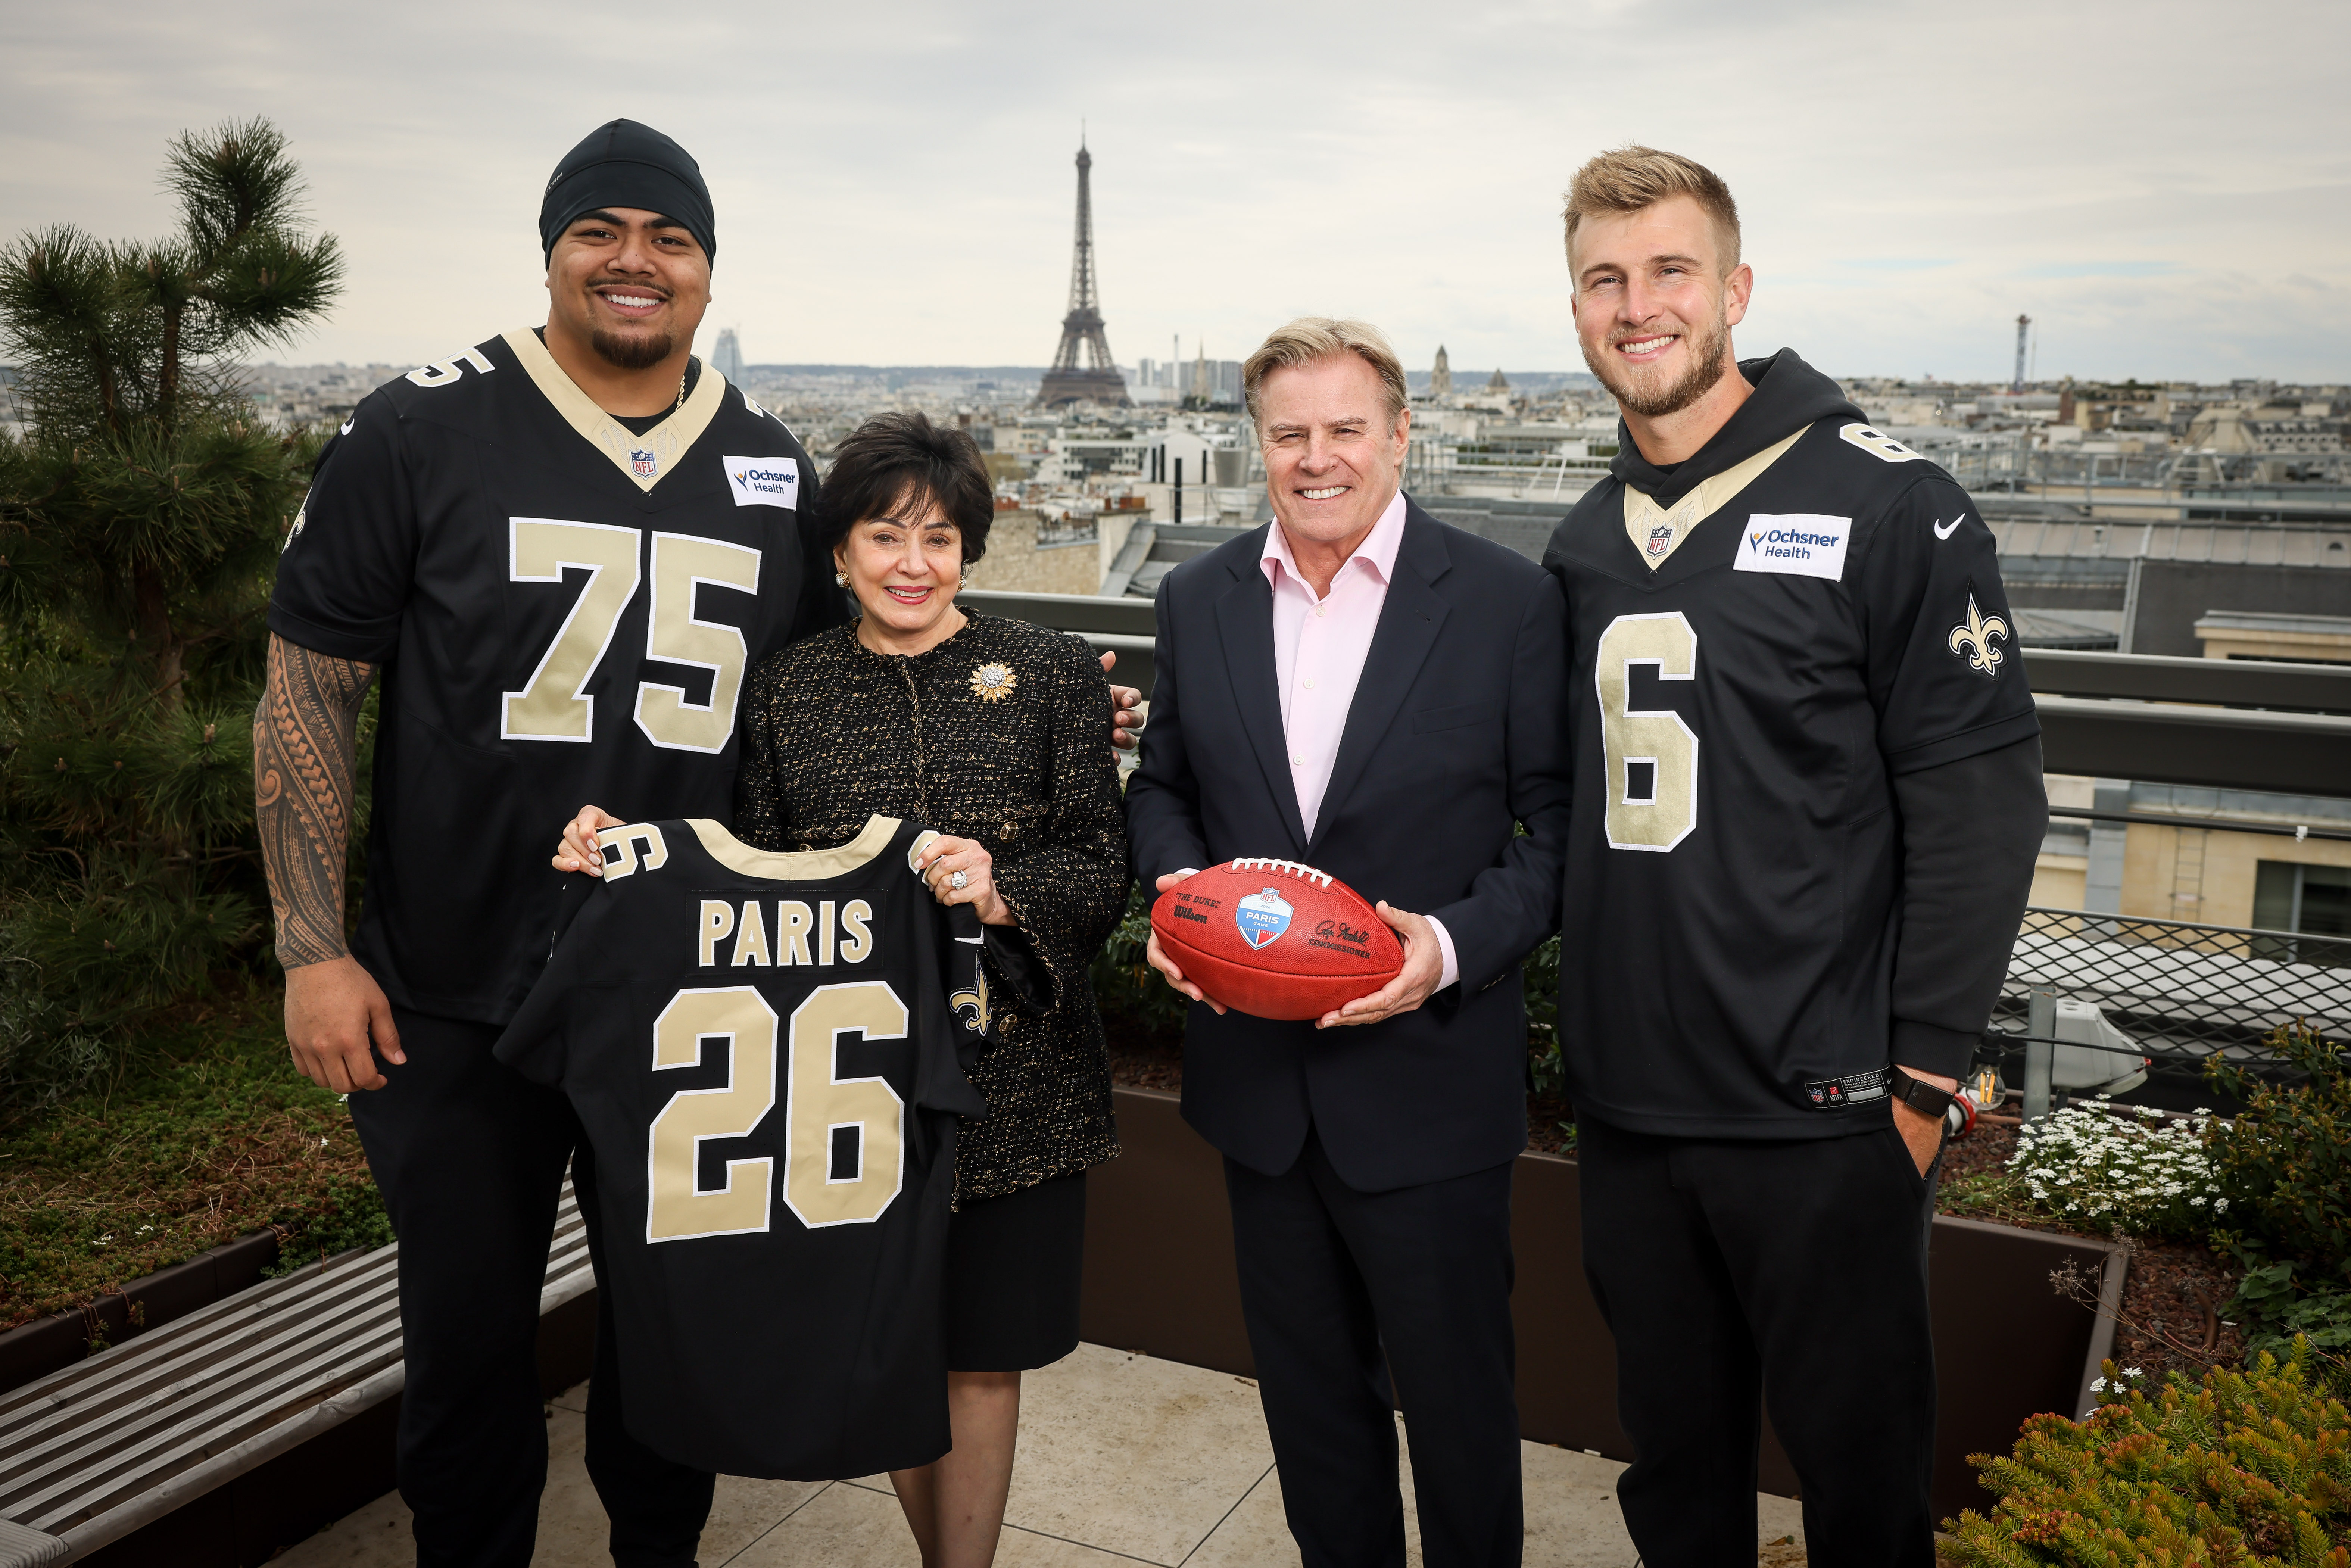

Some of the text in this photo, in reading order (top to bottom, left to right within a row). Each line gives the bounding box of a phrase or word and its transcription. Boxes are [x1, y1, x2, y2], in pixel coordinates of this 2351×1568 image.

[1839, 423, 1926, 463] 6
[635, 461, 654, 474] NFL
[749, 469, 795, 483] Ochsner
[754, 483, 784, 494] Health
[1649, 538, 1666, 552] NFL
[1768, 529, 1839, 547] Ochsner
[1765, 546, 1810, 559] Health
[501, 517, 761, 754] 75
[1595, 611, 1699, 853] 6
[1262, 894, 1275, 902] NFL
[1174, 905, 1207, 924] Wilson
[1246, 911, 1279, 924] PARIS
[699, 899, 873, 967] PARIS
[1309, 939, 1371, 959] COMMISSIONER
[1843, 1073, 1879, 1084] ENGINEERED
[646, 981, 909, 1244] 26
